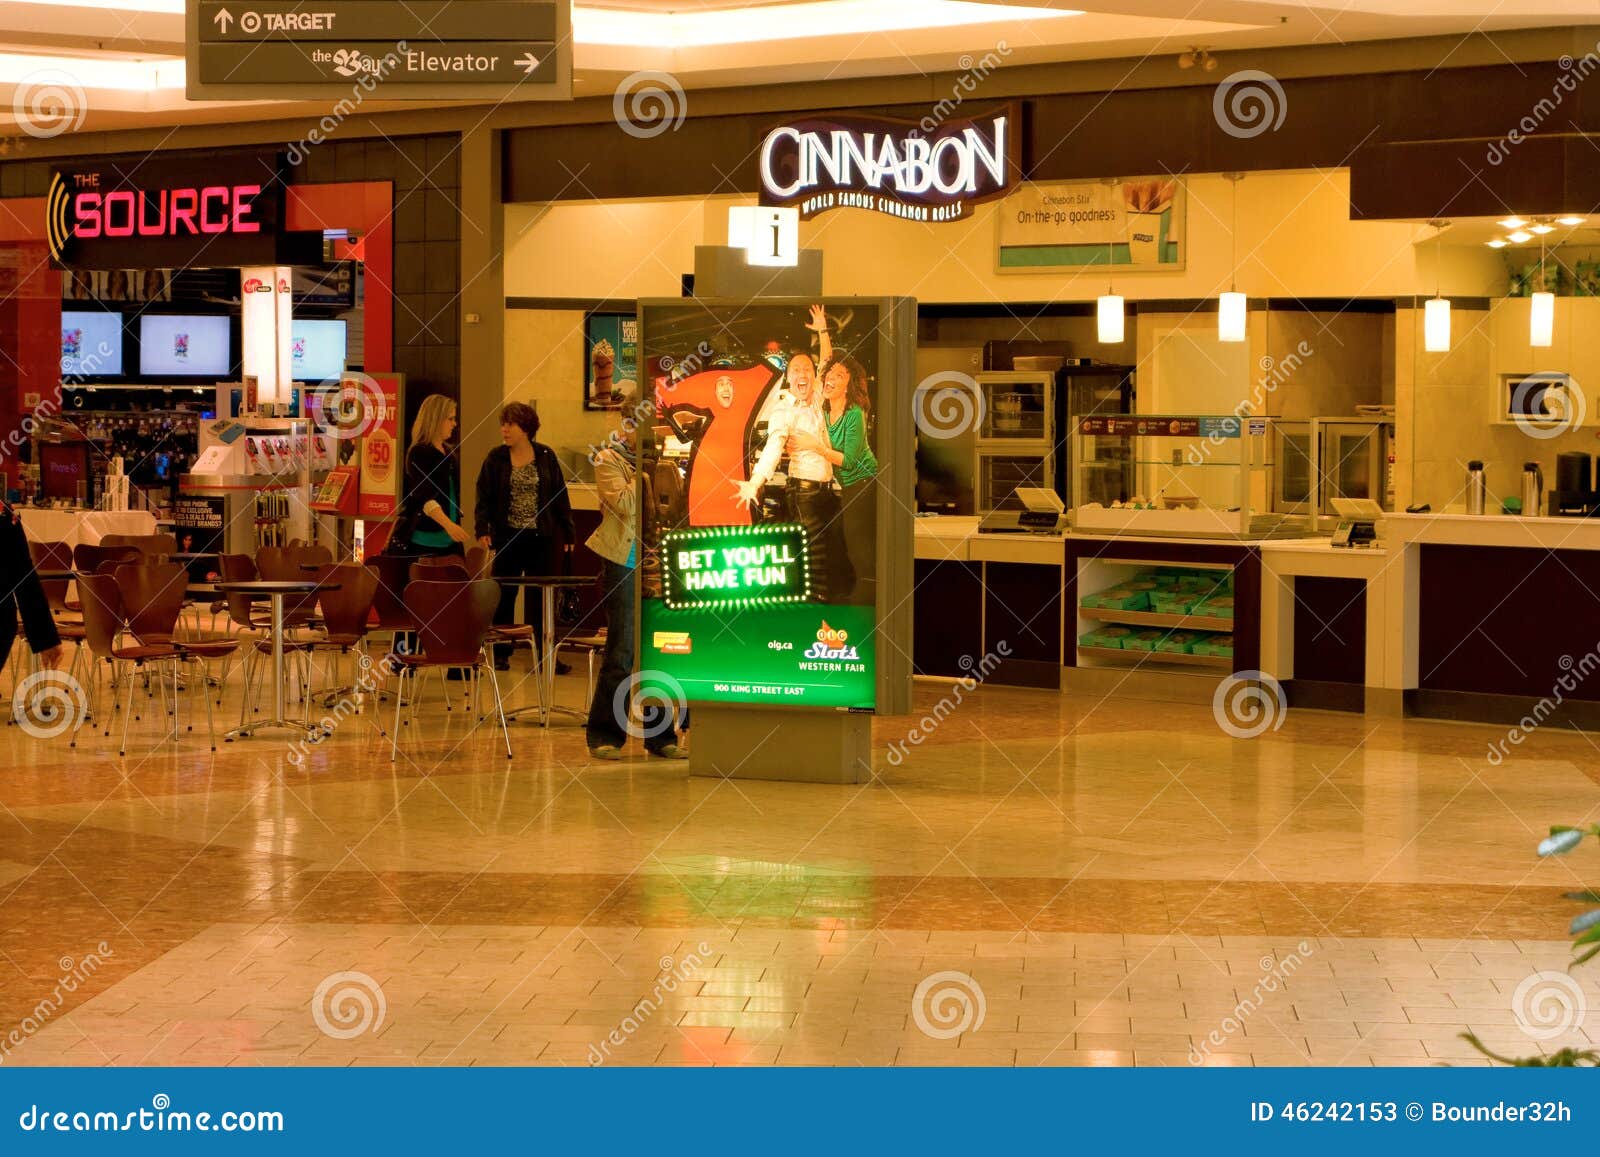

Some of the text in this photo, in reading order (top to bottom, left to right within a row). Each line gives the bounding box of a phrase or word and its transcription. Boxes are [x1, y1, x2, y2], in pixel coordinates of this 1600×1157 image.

[263, 12, 336, 30] TARGET
[312, 49, 332, 62] the
[407, 51, 499, 72] Elevator
[760, 116, 1008, 197] CINNABON
[73, 173, 100, 187] THE
[802, 192, 962, 221] WORLD FAMOUS CINNAMON ROLLS
[1042, 194, 1075, 206] Cinnabon
[74, 184, 261, 238] SOURCE
[1069, 207, 1116, 225] goodness
[364, 406, 397, 421] EVENT
[678, 544, 796, 570] BET YOU'LL
[685, 565, 787, 591] HAVE FUN
[817, 629, 848, 642] OLG
[767, 640, 793, 651] olg.ca
[804, 642, 861, 660] Slots
[798, 661, 866, 673] WESTERN FAIR
[713, 684, 805, 696] 900 KING STREET EAST
